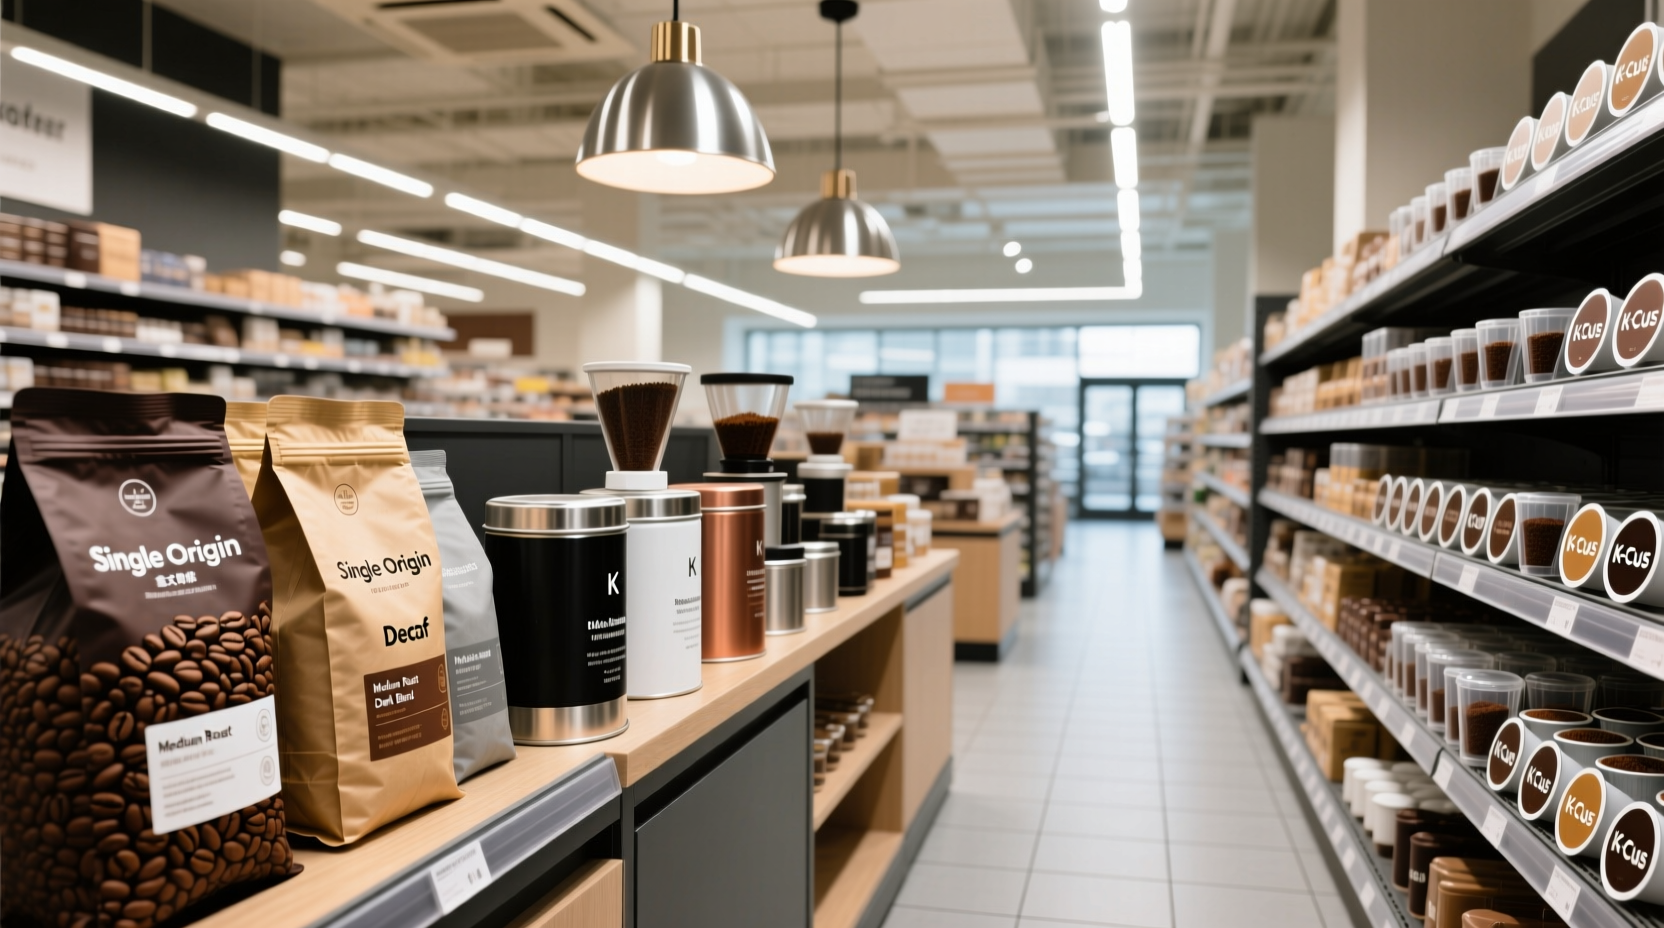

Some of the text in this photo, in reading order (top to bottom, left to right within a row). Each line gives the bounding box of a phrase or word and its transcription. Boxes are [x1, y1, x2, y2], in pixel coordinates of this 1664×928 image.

[88, 534, 242, 578] Single Origin
[756, 539, 763, 556] K
[336, 559, 383, 584] Single
[382, 550, 432, 576] Origin
[688, 556, 697, 577] K
[607, 571, 620, 596] K
[382, 615, 430, 647] Decaf
